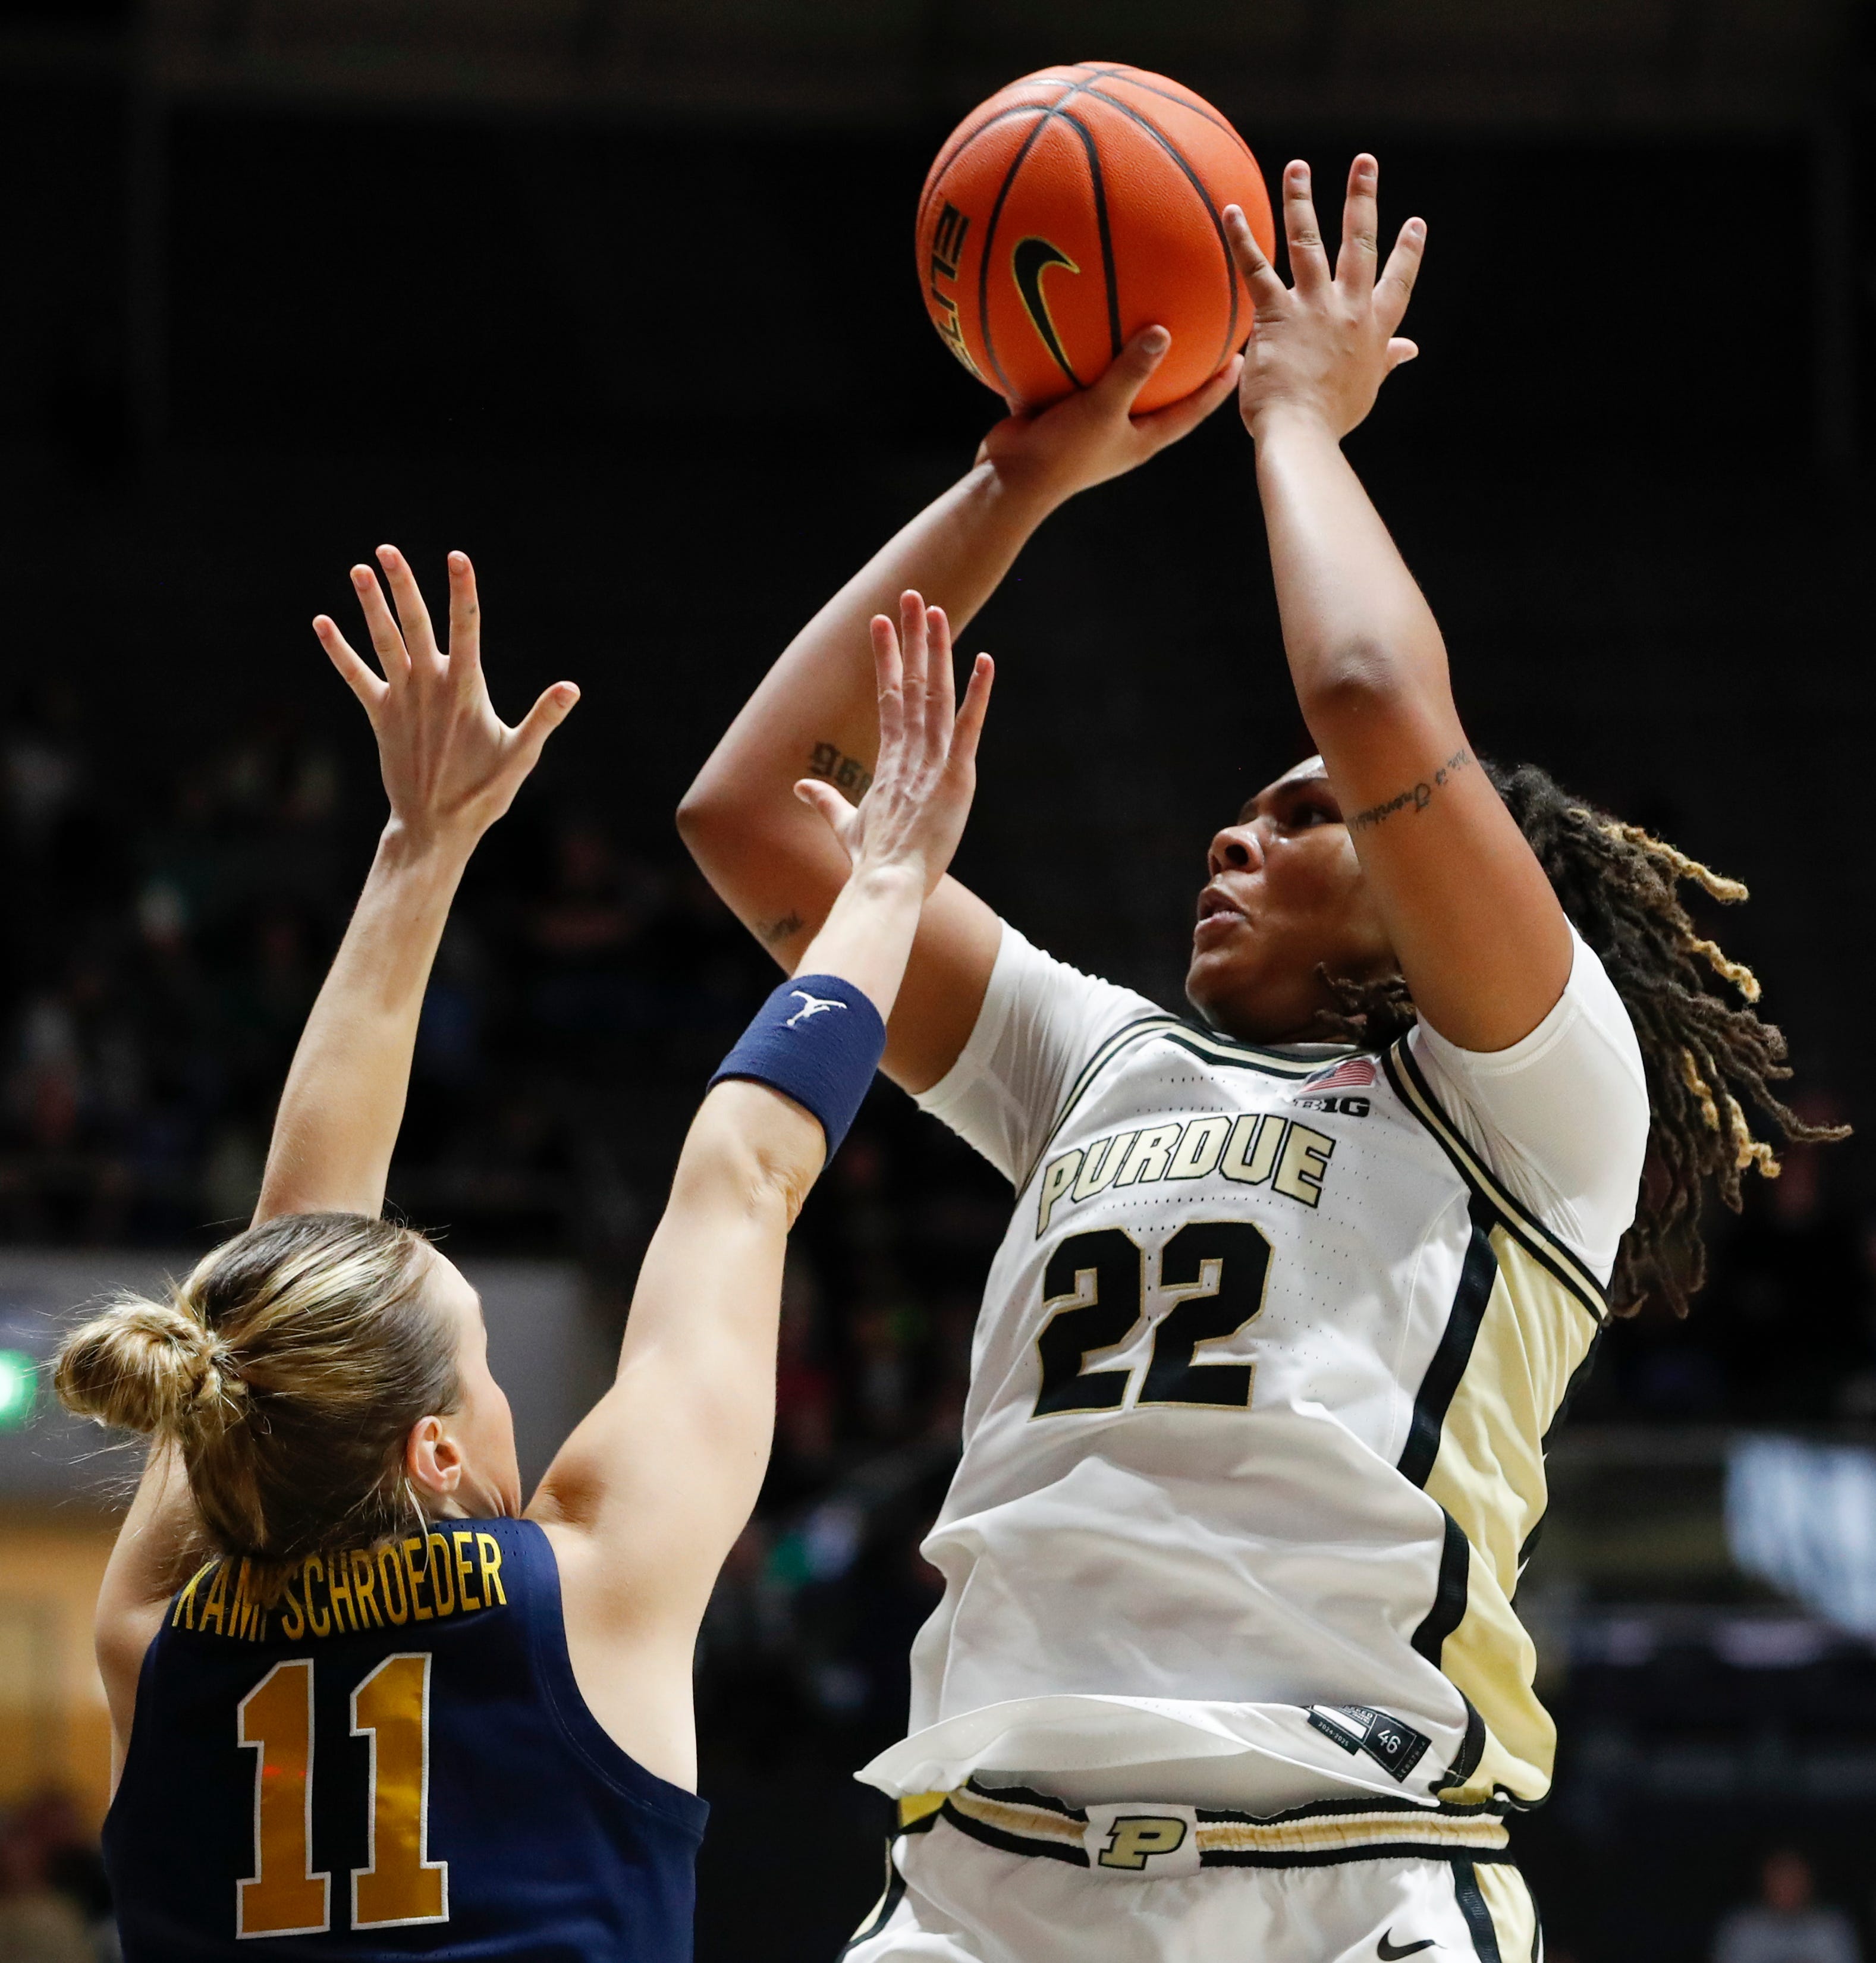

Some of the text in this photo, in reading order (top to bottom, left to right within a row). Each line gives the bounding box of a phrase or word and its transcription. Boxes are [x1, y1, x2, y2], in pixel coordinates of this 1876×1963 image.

[931, 200, 988, 381] ELITE
[1036, 1114, 1337, 1241] PURDUE
[1030, 1220, 1274, 1421] 22
[235, 1651, 450, 1940] 11
[1377, 1729, 1401, 1754] 46
[1098, 1815, 1187, 1871] P
